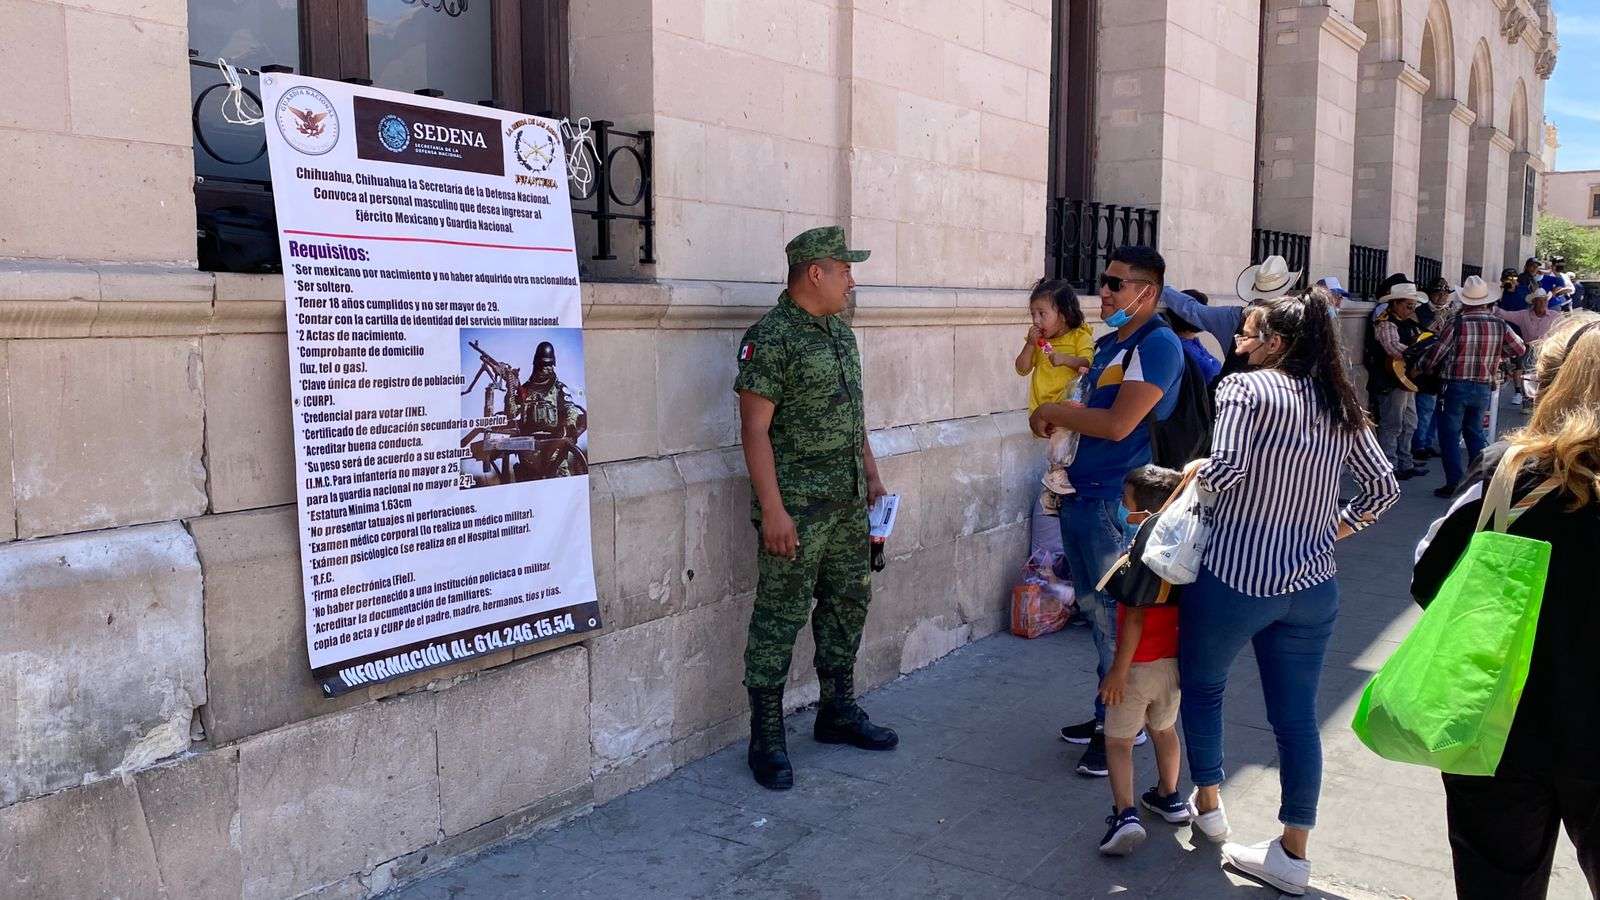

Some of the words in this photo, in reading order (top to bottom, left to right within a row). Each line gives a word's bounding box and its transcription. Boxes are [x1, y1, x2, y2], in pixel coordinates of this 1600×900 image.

[413, 122, 488, 149] SEDENA
[355, 173, 407, 188] Chihuahua
[408, 178, 417, 190] la
[419, 179, 463, 195] Secretaría
[464, 185, 475, 196] de
[476, 187, 484, 197] la
[517, 191, 551, 205] Nacional.
[314, 187, 357, 202] Convoca
[359, 192, 367, 203] al
[370, 194, 413, 207] personal
[414, 197, 458, 211] masculino
[460, 202, 474, 213] que
[476, 203, 500, 215] desea
[502, 206, 533, 218] ingresar
[534, 210, 542, 219] al
[355, 209, 392, 223] Ejército
[395, 212, 438, 226] Mexicano
[446, 217, 477, 230] Guardia
[479, 219, 514, 233] Nacional.
[289, 240, 370, 261] Requisitos:
[314, 265, 360, 277] mexicano
[363, 269, 377, 278] por
[380, 269, 431, 281] nacimiento
[440, 272, 449, 281] no
[450, 271, 473, 282] haber
[475, 273, 512, 284] adquirido
[514, 275, 529, 285] otra
[316, 282, 353, 293] soltero.
[329, 298, 339, 309] 18
[341, 297, 365, 309] años
[366, 300, 414, 311] cumplidos
[421, 301, 433, 311] no
[435, 301, 448, 311] ser
[450, 302, 474, 312] mayor
[476, 302, 486, 312] de
[487, 302, 500, 312] 29.
[335, 314, 352, 325] con
[354, 313, 363, 325] la
[365, 314, 399, 326] cartilla
[400, 315, 411, 326] de
[413, 315, 453, 326] identidad
[455, 316, 469, 326] del
[470, 316, 501, 326] servicio
[503, 316, 528, 326] militar
[306, 330, 335, 341] Actas
[337, 330, 350, 341] de
[352, 330, 406, 341] nacimiento.
[368, 346, 380, 357] de
[382, 346, 425, 357] domicilio
[319, 362, 332, 373] tel
[328, 378, 356, 390] única
[358, 377, 371, 389] de
[373, 376, 410, 389] registro
[412, 375, 423, 387] de
[425, 374, 465, 387] población
[355, 410, 377, 422] para
[379, 408, 404, 420] votar
[356, 424, 367, 436] de
[370, 420, 419, 435] educación
[420, 418, 468, 431] secundaria
[348, 440, 377, 452] buena
[379, 437, 424, 449] conducta.
[320, 460, 340, 474] peso
[342, 455, 362, 468] será
[364, 454, 376, 466] de
[377, 450, 415, 466] acuerdo
[424, 449, 437, 460] su
[333, 473, 352, 486] Para
[354, 468, 397, 482] infantería
[399, 468, 409, 478] no
[412, 466, 440, 478] mayor
[307, 493, 328, 506] para
[330, 491, 338, 502] la
[339, 487, 372, 501] guardia
[373, 484, 411, 498] nacional
[413, 483, 424, 493] no
[425, 479, 452, 492] mayor
[381, 498, 412, 511] 1.63cm
[325, 519, 367, 536] presentar
[368, 514, 405, 527] tatuajes
[416, 505, 476, 521] perforaciones.
[350, 533, 379, 546] médico
[381, 526, 419, 543] corporal
[433, 520, 461, 533] realiza
[463, 519, 473, 528] un
[474, 512, 503, 527] médico
[400, 542, 414, 553] (se
[416, 536, 445, 551] realiza
[446, 535, 456, 546] en
[458, 533, 466, 544] el
[467, 528, 500, 544] Hospital
[340, 578, 391, 597] electrónica
[327, 600, 354, 615] haber
[356, 586, 408, 610] pertenecido
[416, 584, 432, 595] una
[358, 612, 368, 624] la
[369, 599, 434, 621] documentación
[436, 597, 446, 606] de
[448, 588, 492, 603] familiares:
[314, 635, 338, 651] copia
[340, 631, 351, 644] de
[353, 627, 373, 641] acta
[381, 620, 404, 635] CURP
[405, 616, 415, 629] de
[417, 615, 425, 626] el
[339, 642, 451, 686] INFORMACIÓN
[451, 638, 475, 659] AL:
[474, 613, 575, 653] 614.246.15.54
